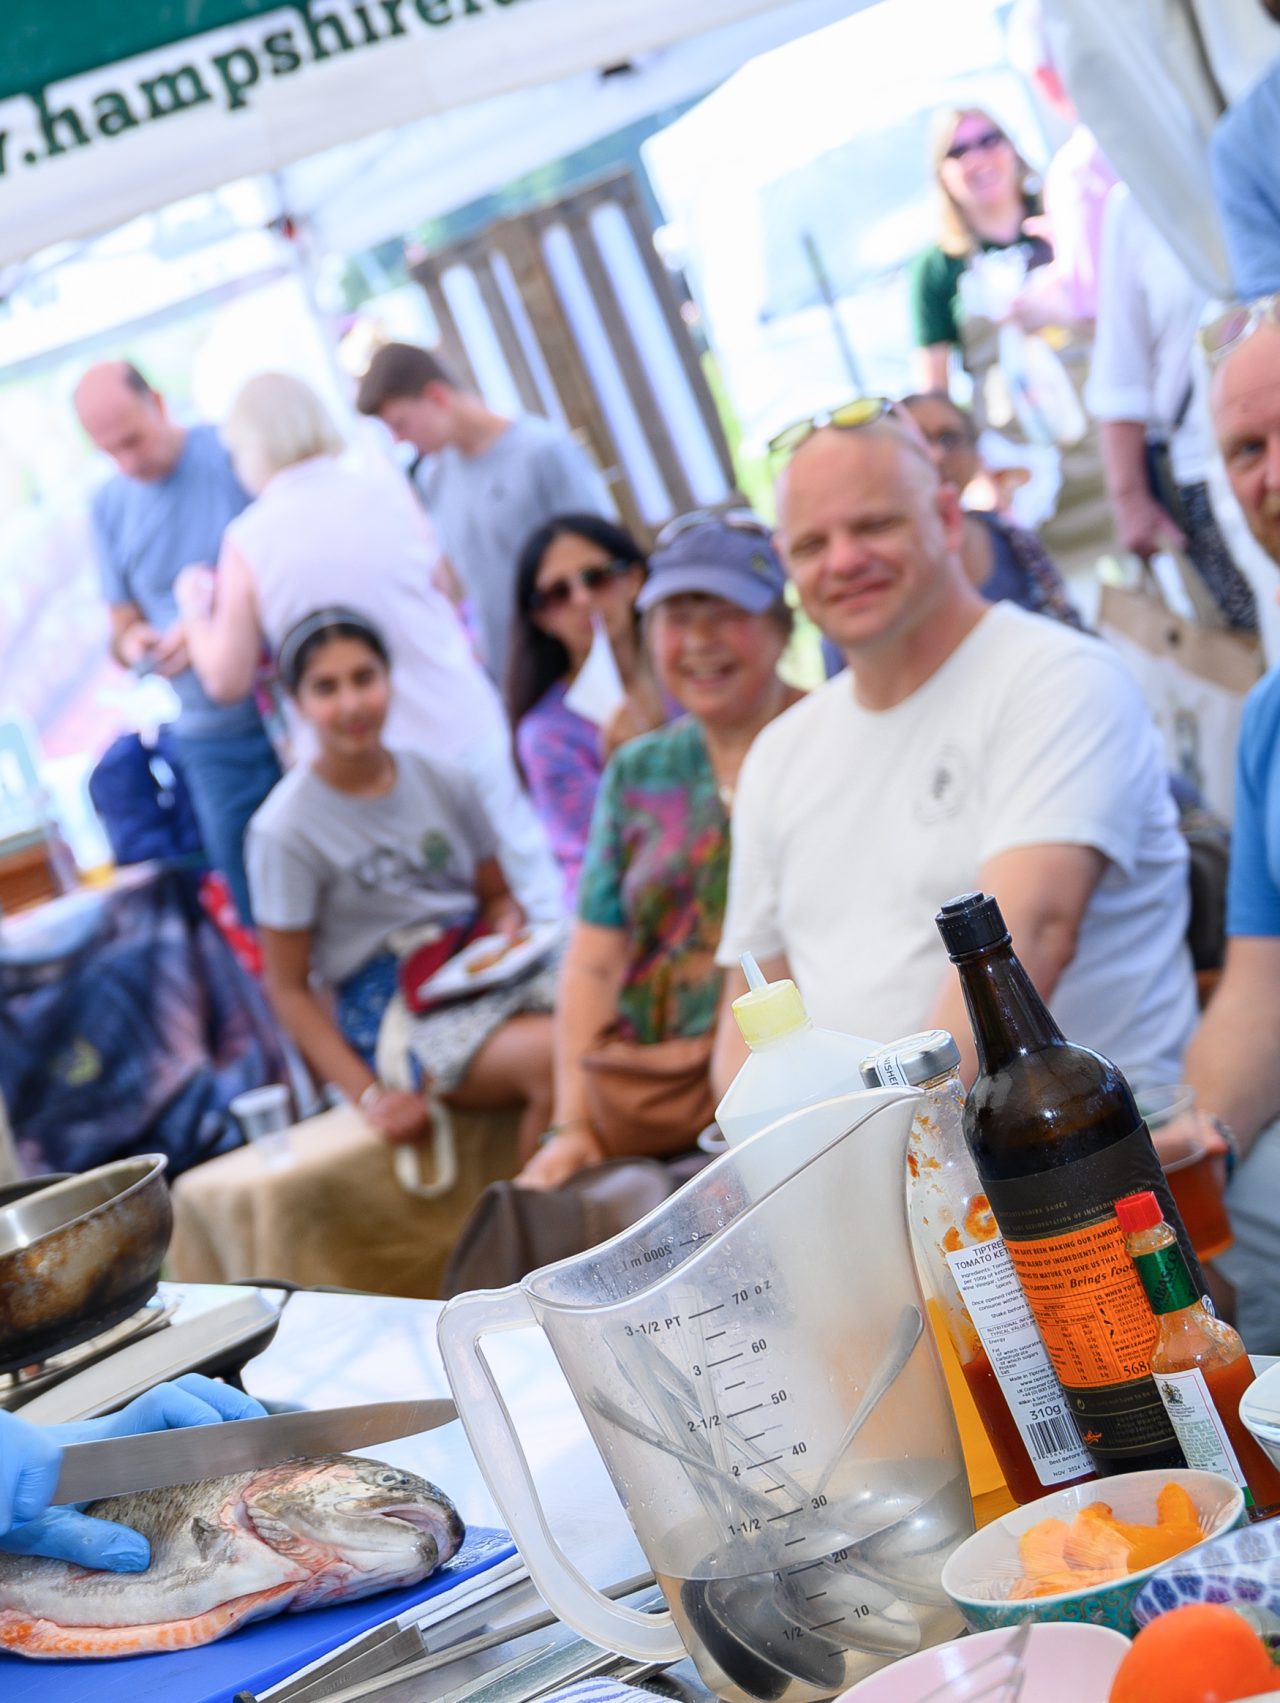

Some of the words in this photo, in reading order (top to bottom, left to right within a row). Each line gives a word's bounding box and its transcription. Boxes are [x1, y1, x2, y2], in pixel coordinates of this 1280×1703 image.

[1048, 1240, 1076, 1252] MAKING
[1076, 1236, 1092, 1246] OUR
[1093, 1224, 1122, 1241] FAMOUS
[1052, 1248, 1097, 1265] INGREDIENTS
[1097, 1241, 1115, 1253] THAT
[955, 1254, 992, 1271] TOMATO
[1062, 1268, 1072, 1276] TO
[1073, 1263, 1090, 1274] GIVE
[1090, 1260, 1100, 1269] US
[1101, 1254, 1119, 1265] THAT
[1070, 1272, 1107, 1289] Brings
[1151, 1250, 1177, 1310] ABASCO
[731, 1289, 749, 1305] 70
[1104, 1288, 1123, 1298] WHEN
[991, 1311, 1007, 1319] Shake
[1007, 1305, 1025, 1314] before
[624, 1321, 661, 1337] 3-1/2
[664, 1315, 681, 1330] PT
[751, 1338, 767, 1354] 60
[692, 1365, 702, 1377] 3
[770, 1389, 788, 1406] 50
[1030, 1404, 1062, 1421] 310g
[687, 1414, 722, 1433] 2-1/2
[791, 1441, 808, 1457] 40
[731, 1465, 741, 1478] 2
[811, 1494, 828, 1511] 30
[728, 1518, 762, 1536] 1-1/2
[831, 1549, 849, 1564] 20
[775, 1572, 783, 1583] 1
[852, 1604, 870, 1620] 10
[781, 1625, 804, 1642] 1/2
